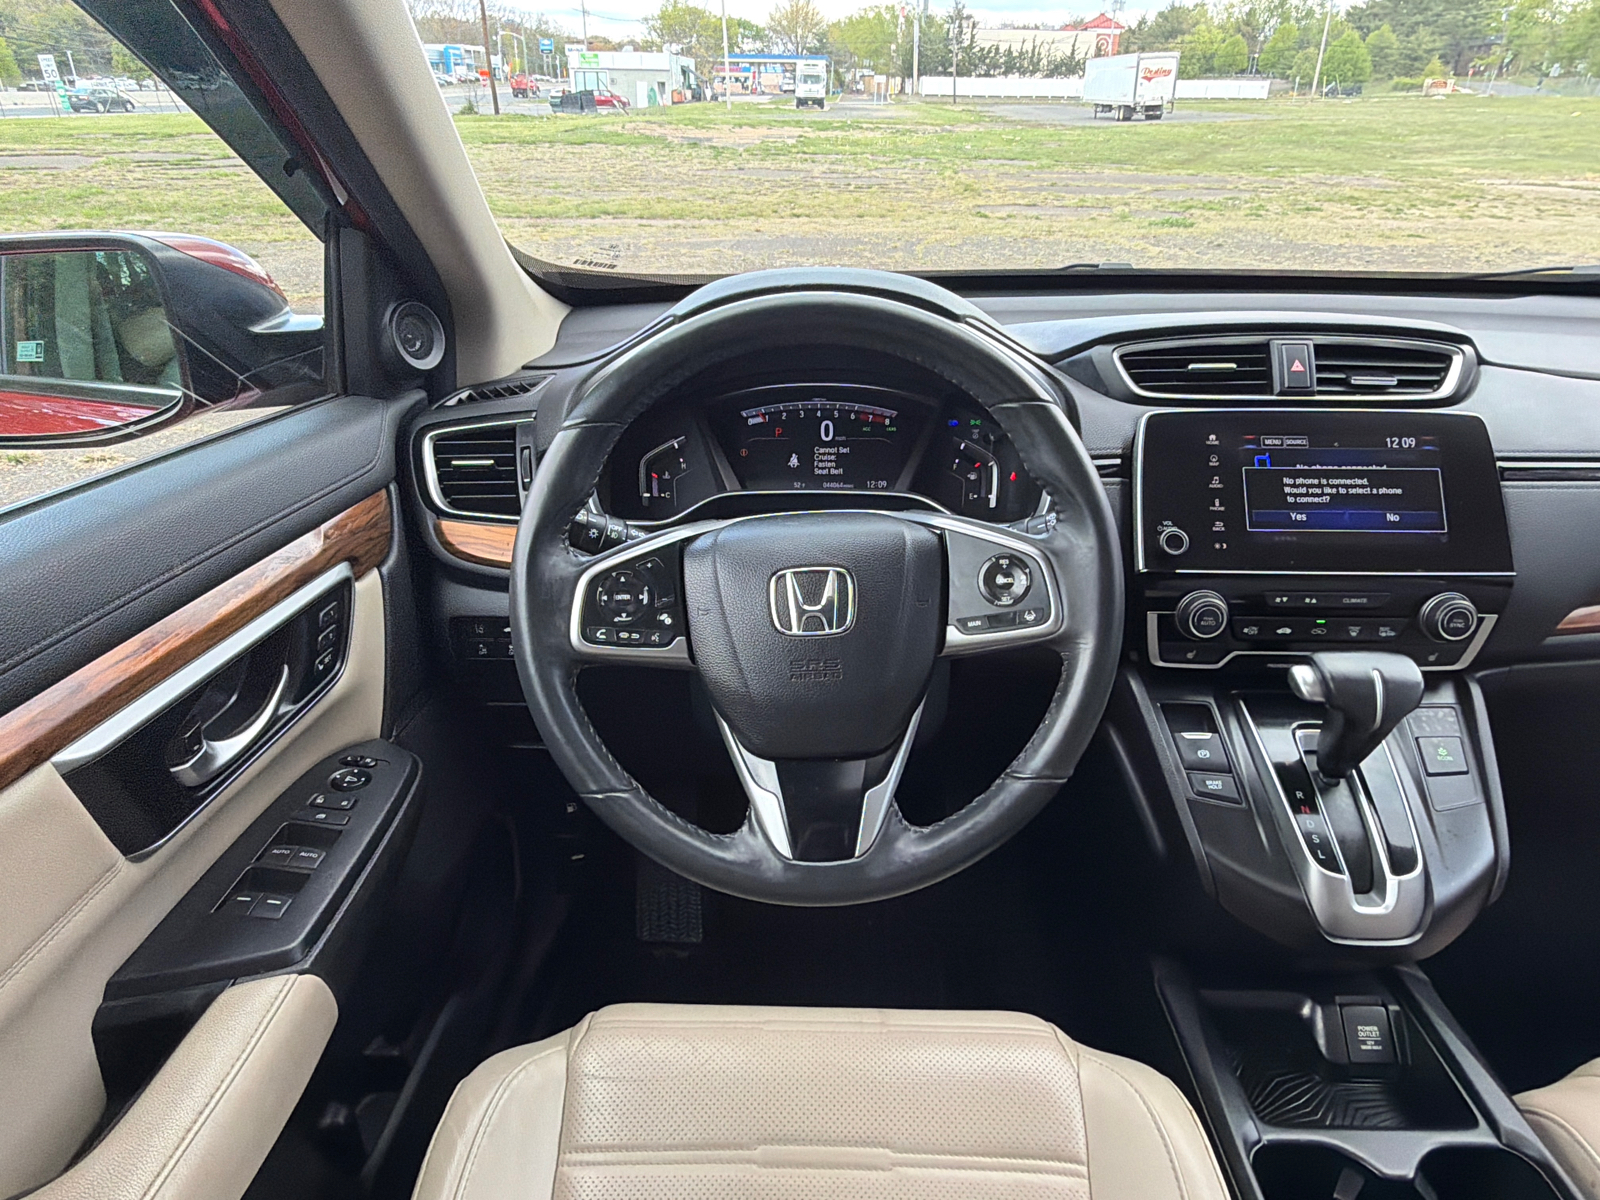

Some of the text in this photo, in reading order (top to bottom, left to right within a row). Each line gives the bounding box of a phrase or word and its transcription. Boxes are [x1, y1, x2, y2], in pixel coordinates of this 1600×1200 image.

[44, 69, 58, 78] 50
[1142, 66, 1173, 77] Destiny
[782, 412, 787, 420] 2
[799, 410, 804, 418] 3
[833, 410, 839, 418] 5
[850, 412, 855, 420] 6
[867, 414, 873, 422] 7
[884, 418, 890, 426] 8
[775, 427, 783, 438] P
[820, 420, 834, 442] 0
[814, 446, 850, 454] Cannot Set
[866, 480, 888, 488] 12:09
[1283, 477, 1294, 485] No
[1295, 477, 1319, 487] phone
[1320, 477, 1327, 485] is
[1283, 486, 1307, 494] Would
[1308, 487, 1322, 495] you
[1323, 486, 1337, 494] like
[1378, 487, 1403, 496] phone
[1286, 495, 1330, 503] to connect?
[1290, 512, 1307, 521] Yes
[1386, 513, 1400, 522] No
[1295, 790, 1305, 799] R
[1300, 805, 1311, 814] N
[1306, 820, 1315, 828] D
[1312, 834, 1320, 843] S
[1317, 849, 1326, 859] L
